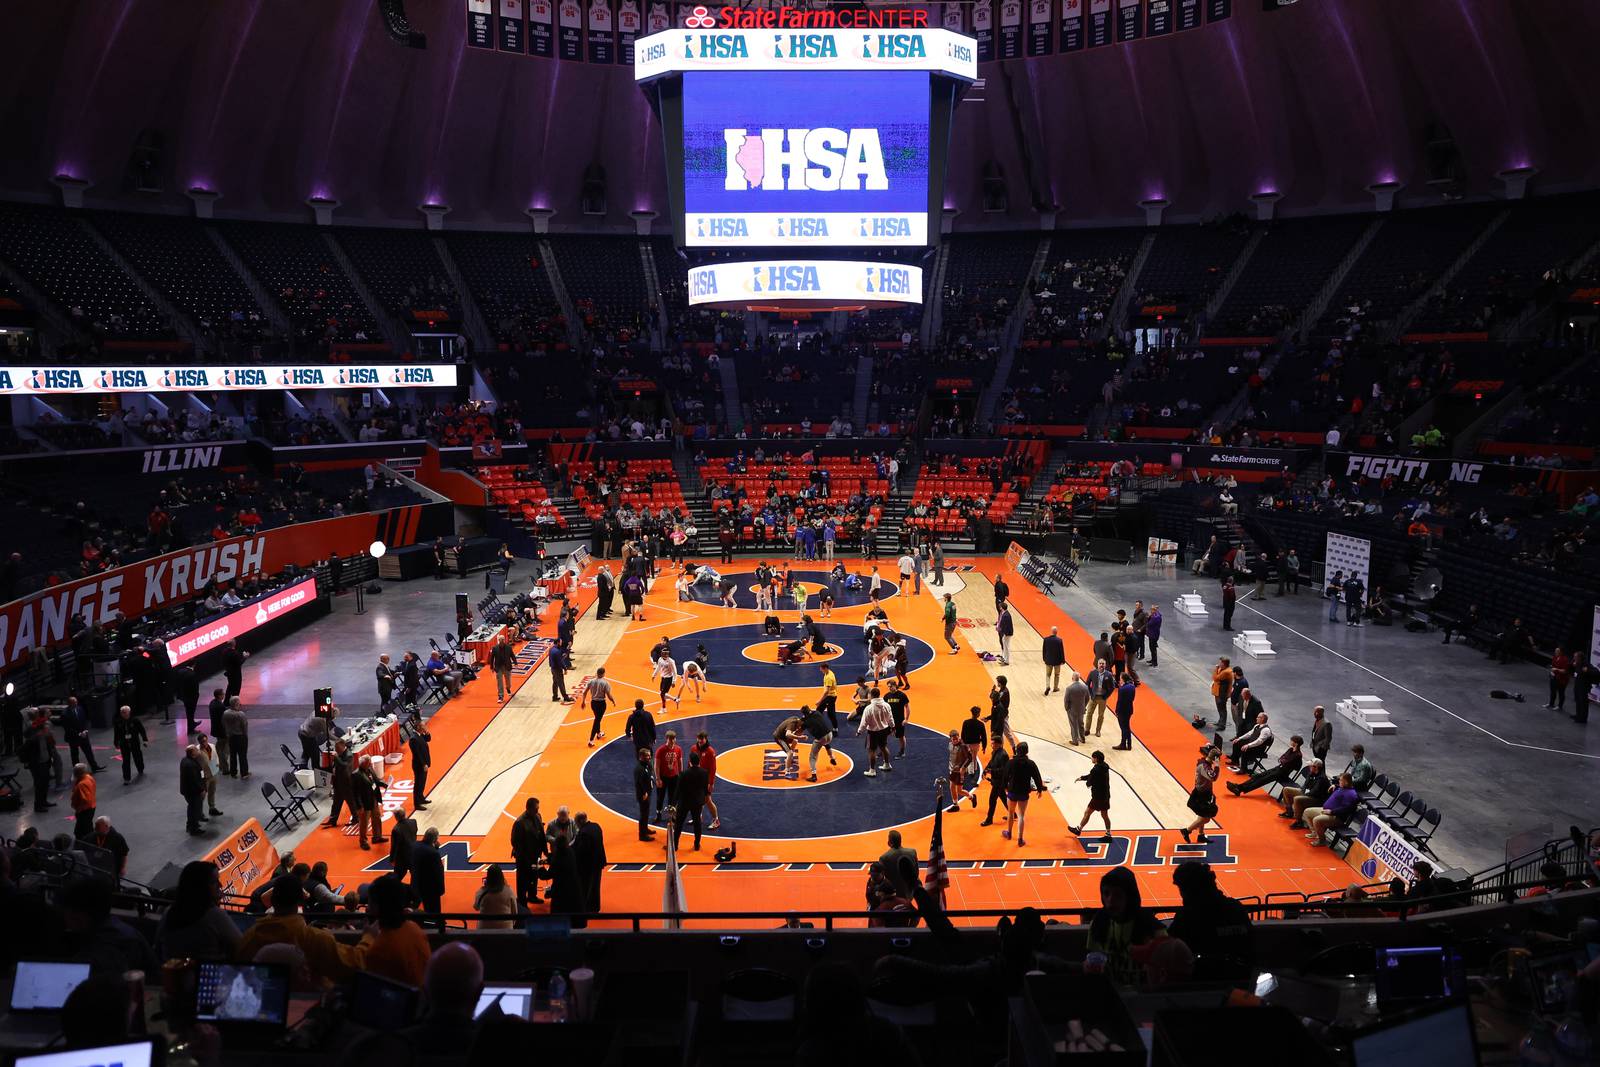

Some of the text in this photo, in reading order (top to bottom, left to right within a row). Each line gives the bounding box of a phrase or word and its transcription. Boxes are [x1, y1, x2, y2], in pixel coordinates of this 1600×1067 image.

[838, 9, 928, 27] CENTER
[724, 127, 889, 191] IHSA
[142, 446, 222, 474] ILLINI
[144, 537, 266, 608] KRUSH
[267, 590, 305, 614] HERE FOR GOOD
[178, 625, 229, 656] HERE FOR GOOD
[1377, 831, 1420, 869] CAREERS
